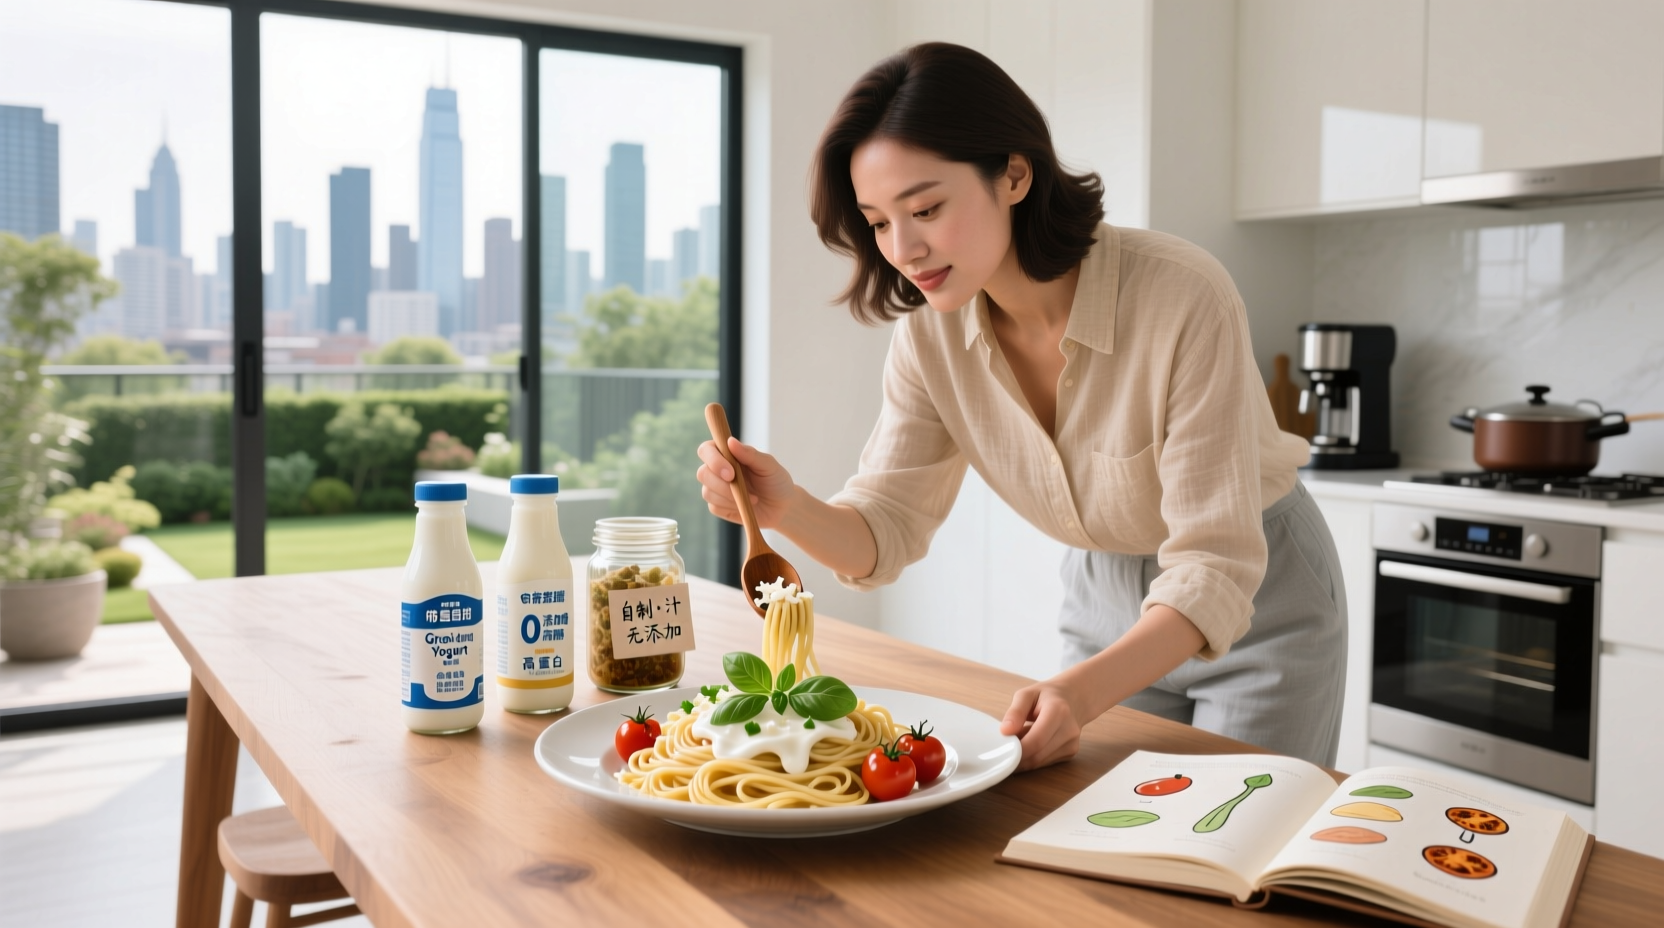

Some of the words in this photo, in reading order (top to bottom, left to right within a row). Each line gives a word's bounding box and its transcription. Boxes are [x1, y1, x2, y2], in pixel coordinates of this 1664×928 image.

[521, 614, 541, 644] 0
[627, 622, 681, 644] 无添加
[431, 645, 468, 659] Yogurt
